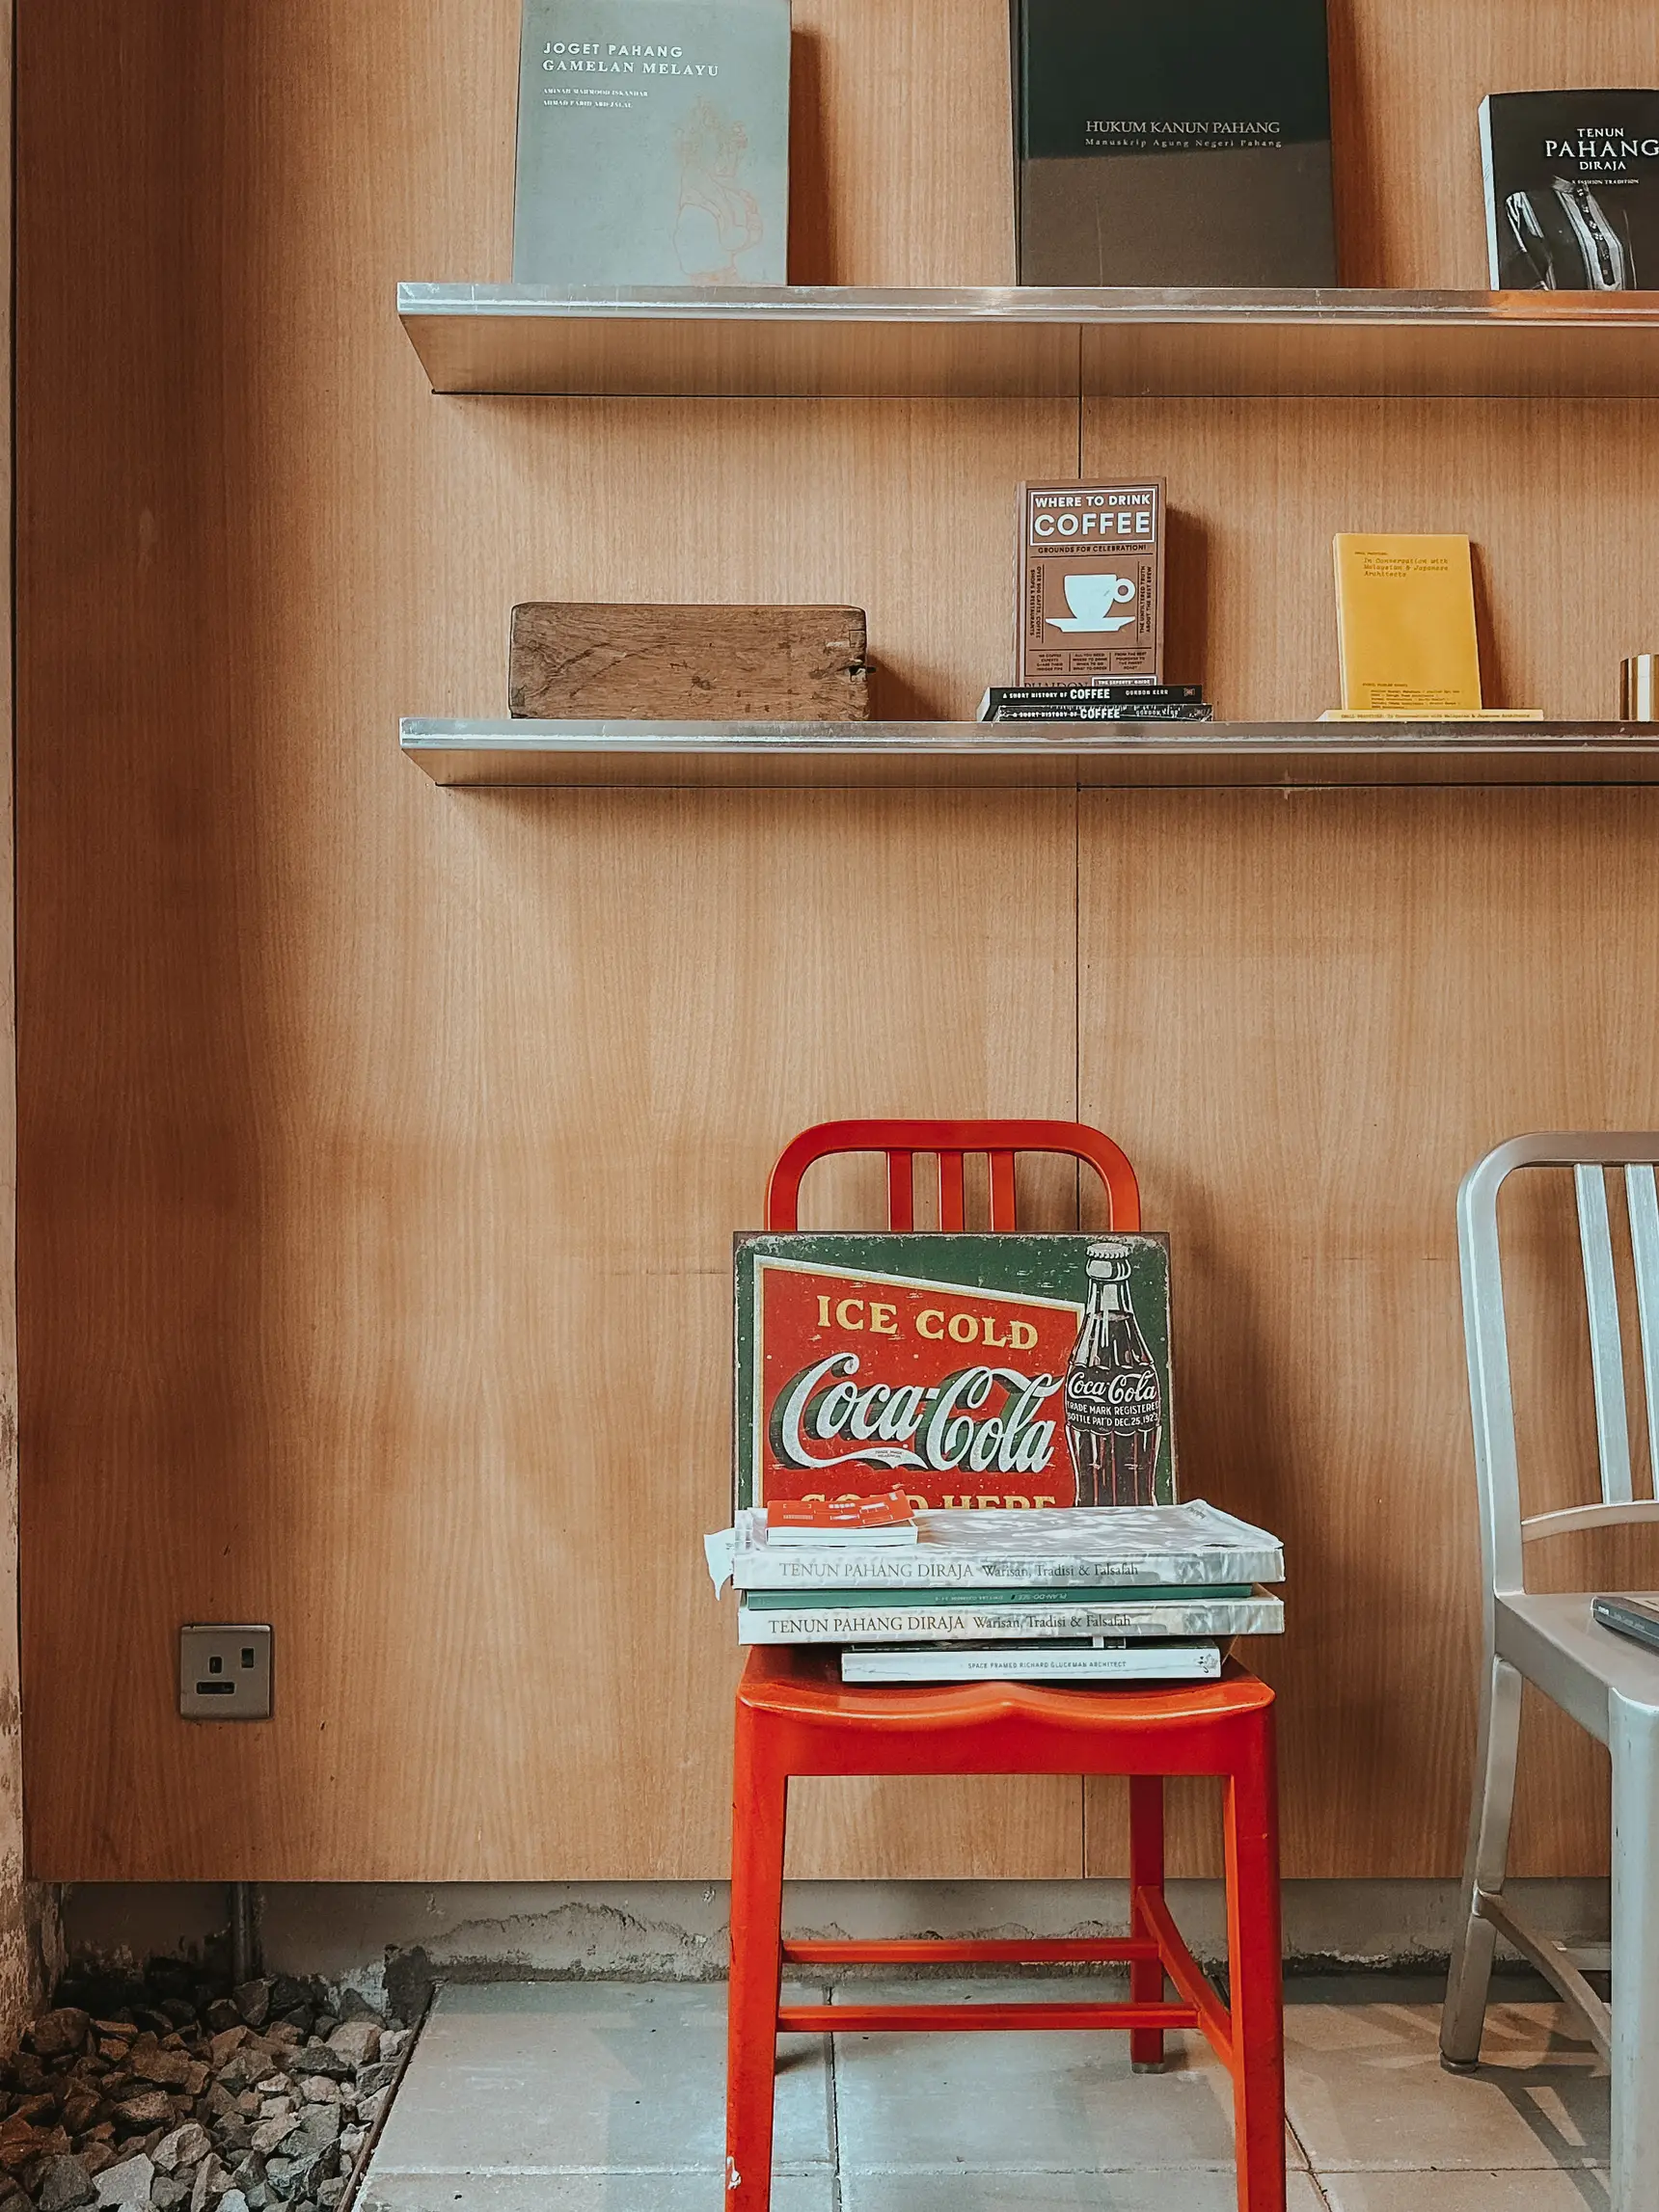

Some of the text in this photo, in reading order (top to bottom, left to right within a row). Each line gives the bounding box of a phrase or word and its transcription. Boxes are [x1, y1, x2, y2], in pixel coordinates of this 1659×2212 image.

[543, 42, 684, 58] JOGET PAHANG
[542, 60, 719, 76] GAMELAN MELAYU
[1085, 121, 1280, 134] HUKUM KANUN PAHANG
[1577, 127, 1624, 138] TENUN
[1085, 138, 1282, 148] Manuskrip Agung Negeri Pahang
[1545, 139, 1659, 157] PAHANG
[1580, 161, 1626, 171] DIRAJA
[1035, 494, 1151, 507] WHERE TO DRINK
[1034, 511, 1151, 536] COFFEE
[1070, 688, 1110, 699] COFFEE
[1080, 708, 1120, 719] COFFEE
[817, 1295, 1038, 1350] ICE COLD
[1069, 1370, 1156, 1404] Coca-Cola
[780, 1352, 1065, 1472] Coca-Cola
[1067, 1401, 1088, 1414] TRADE
[1089, 1405, 1112, 1416] MARK
[1067, 1412, 1091, 1424] BOTTLE
[779, 1563, 1139, 1579] TENUN PAHANG DIRAJA Warisan, Tradisi & Falsafah
[768, 1614, 1131, 1634] TENUN PAHANG DIRAJA Warisan, Tradisi & Falsafah
